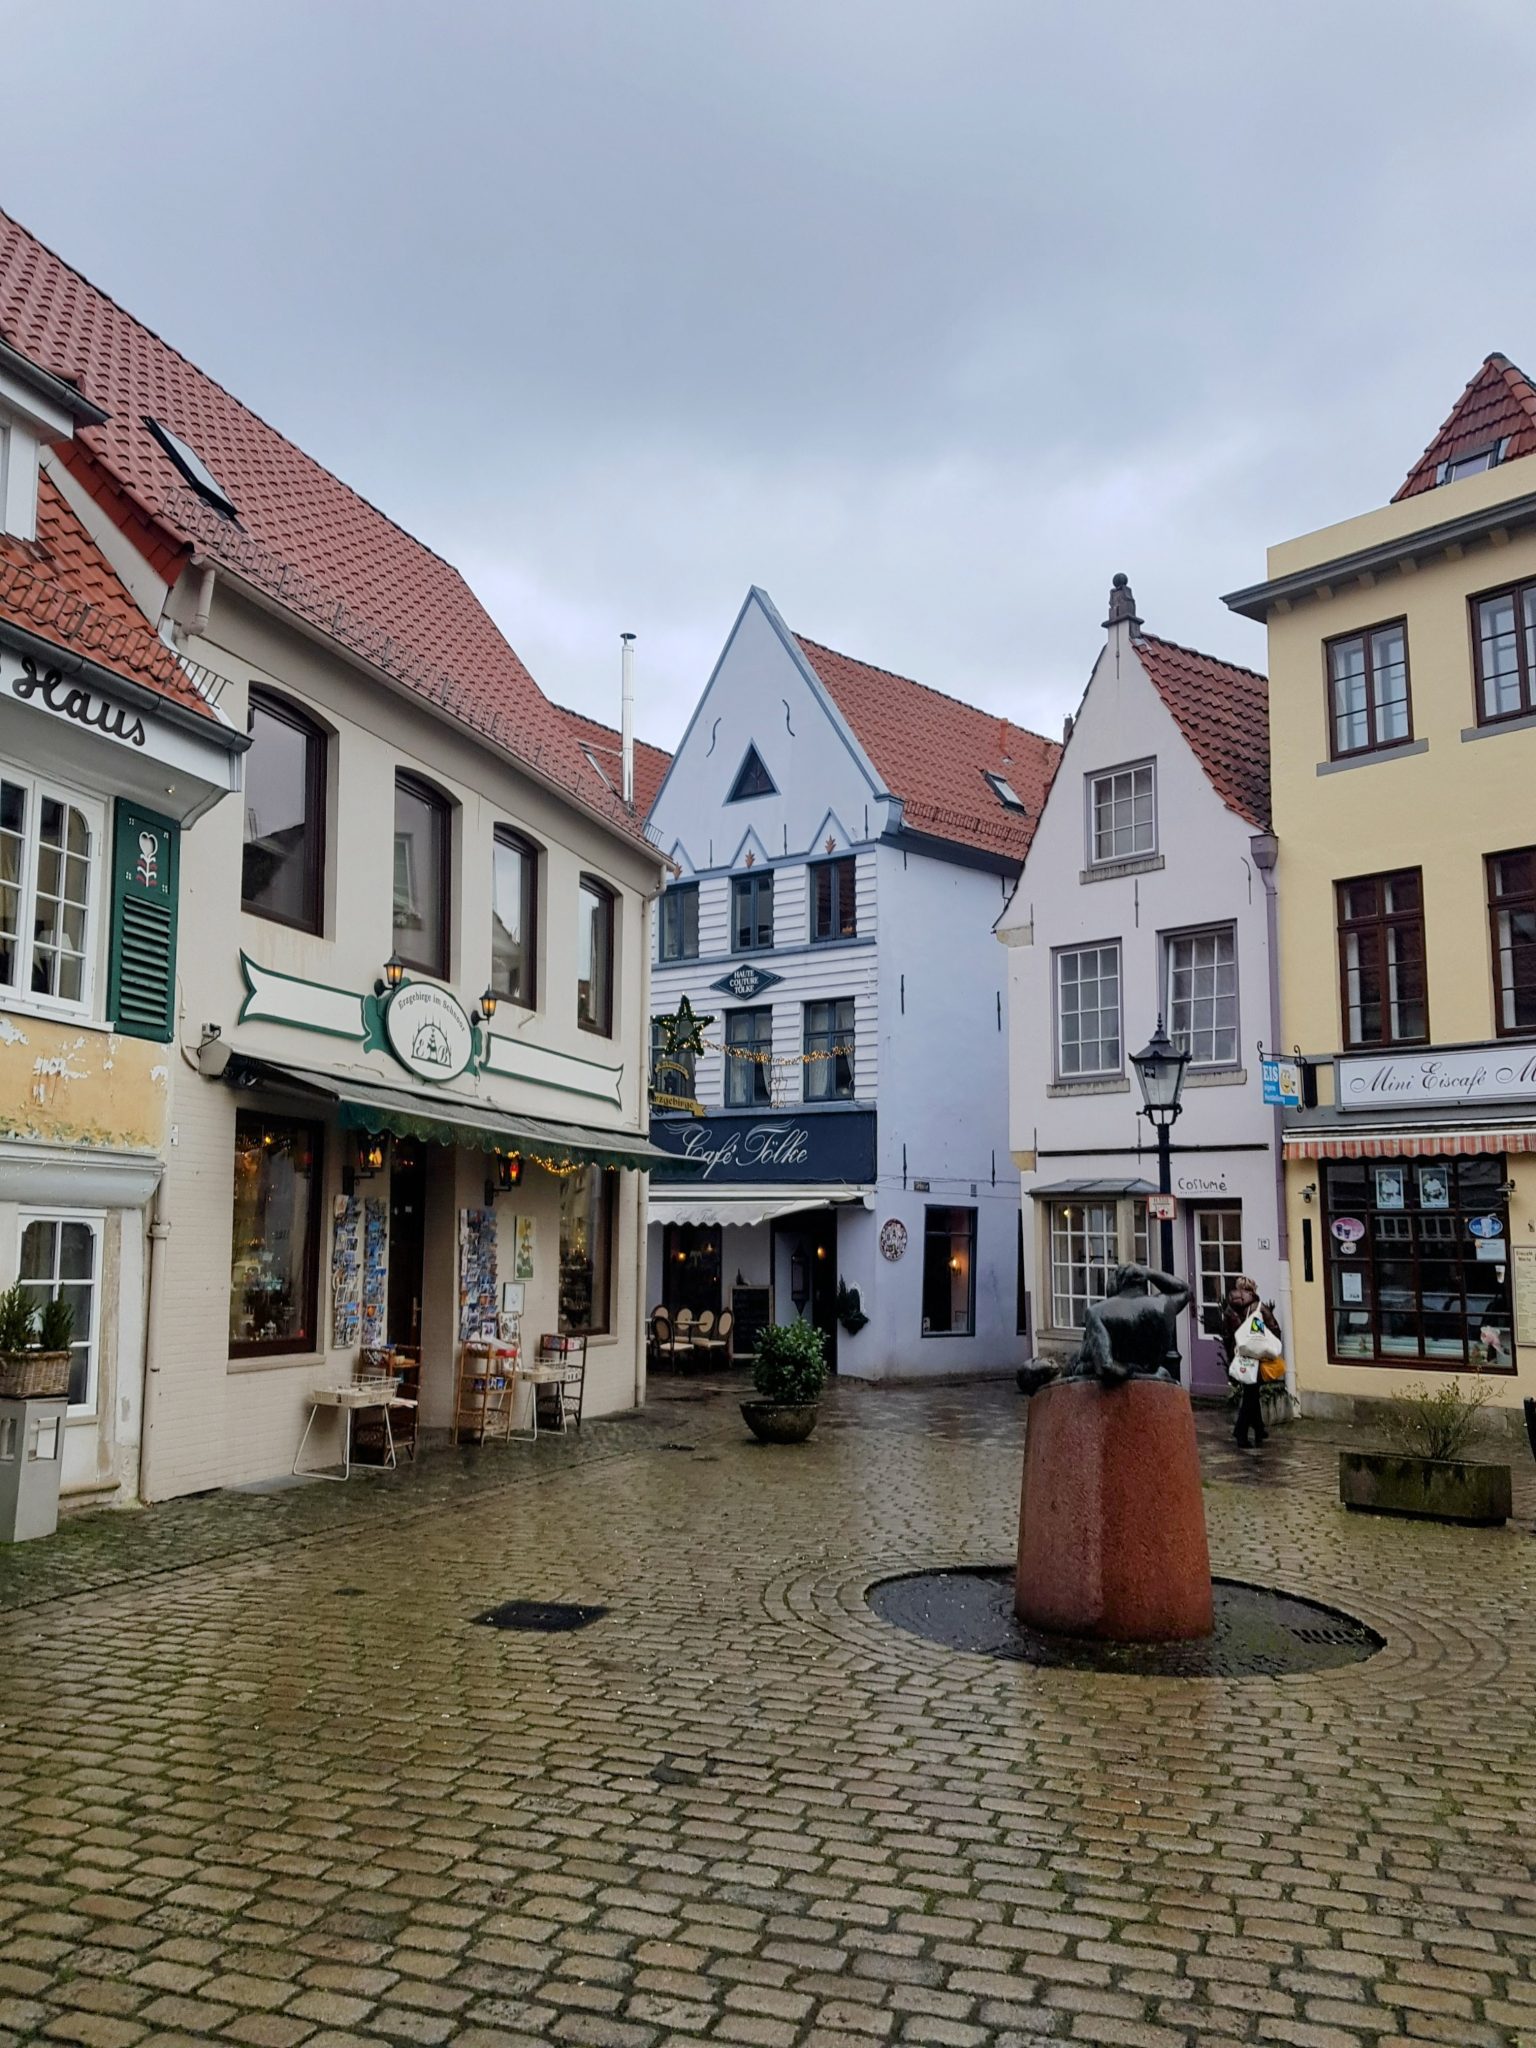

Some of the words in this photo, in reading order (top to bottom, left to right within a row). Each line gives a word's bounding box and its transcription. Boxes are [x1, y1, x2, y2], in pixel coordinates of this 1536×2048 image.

[12, 655, 145, 746] Haus
[729, 976, 759, 987] COUTURE
[733, 969, 755, 979] HAUTE
[398, 991, 432, 1010] Erzgebirge
[433, 994, 442, 1005] im
[443, 1000, 465, 1032] Schnoor
[1263, 1065, 1279, 1082] EIS
[1350, 1066, 1415, 1093] Mini
[1420, 1062, 1487, 1094] Eiscafé
[664, 1122, 740, 1180] Café
[735, 1118, 809, 1167] Tölke
